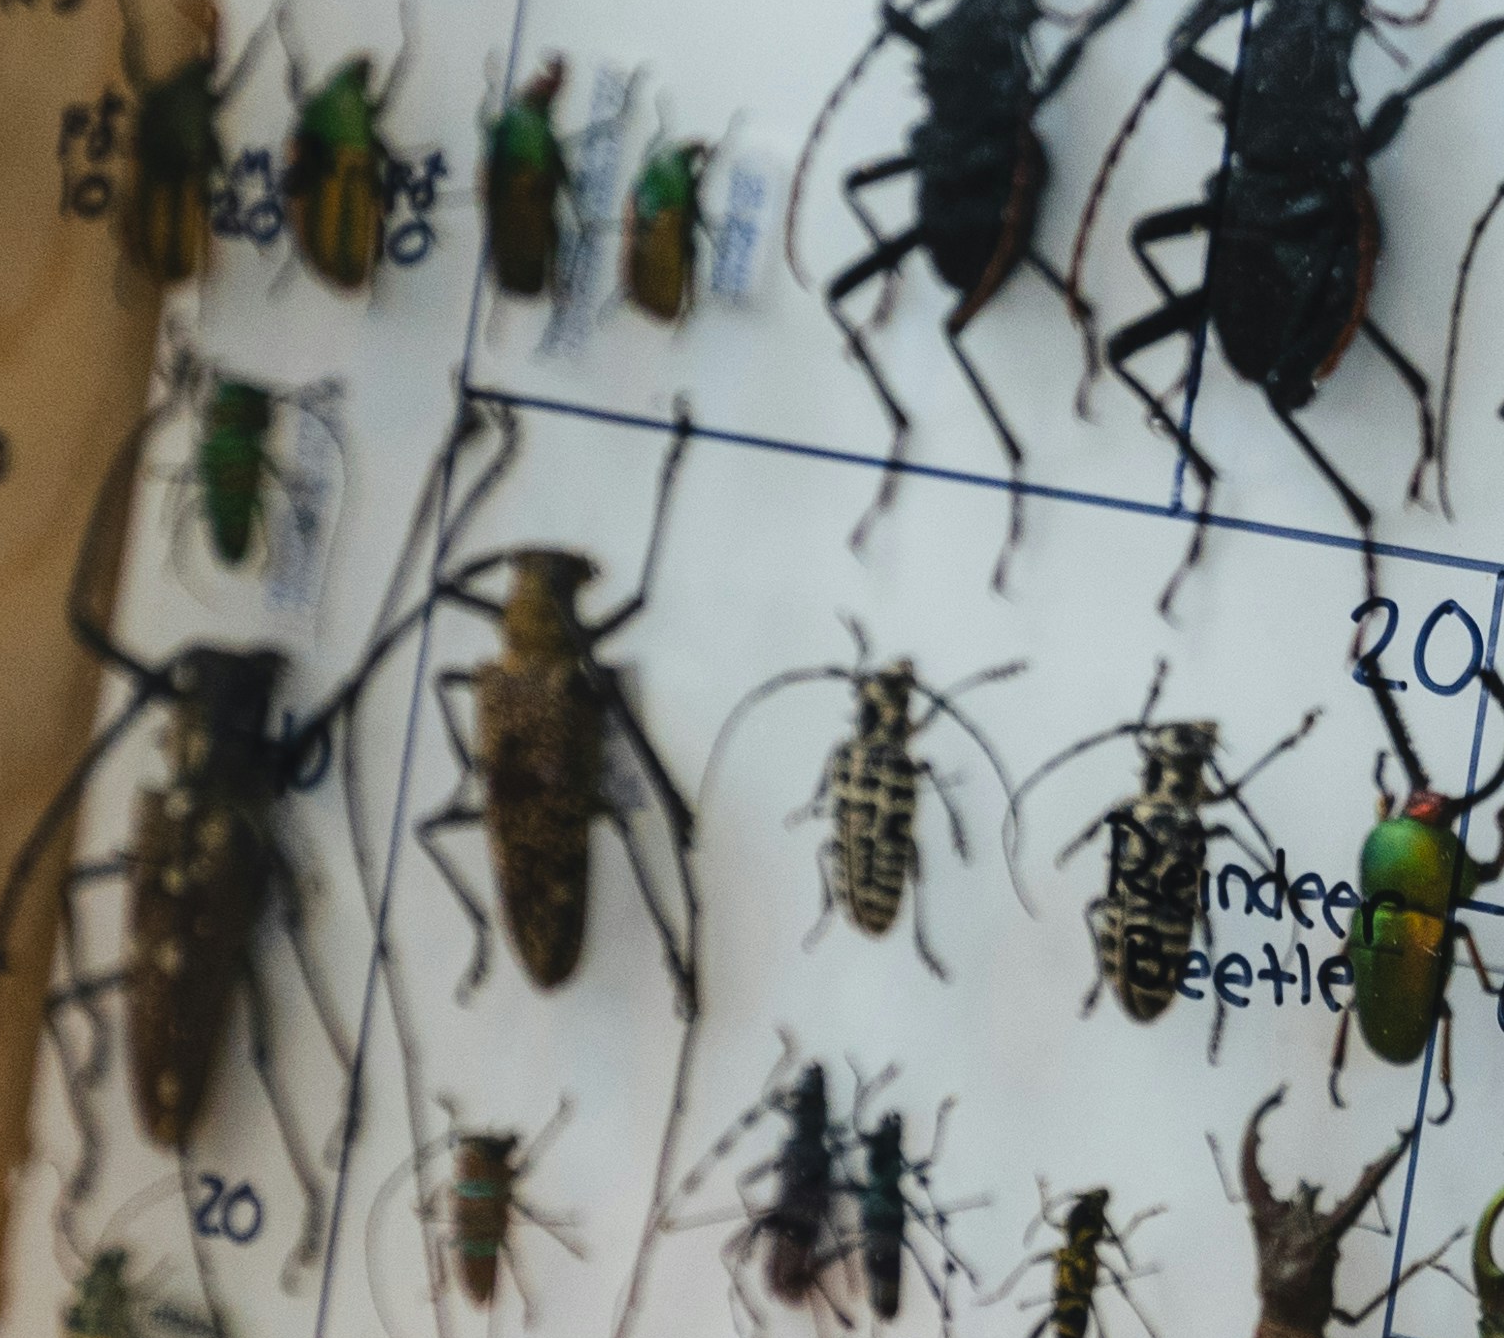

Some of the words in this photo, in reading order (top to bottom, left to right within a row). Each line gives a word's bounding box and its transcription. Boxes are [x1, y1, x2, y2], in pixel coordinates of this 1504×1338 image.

[1349, 597, 1486, 695] 20
[1105, 810, 1408, 945] Reindeer
[1124, 924, 1355, 1013] Beetle
[196, 1172, 264, 1245] 20
